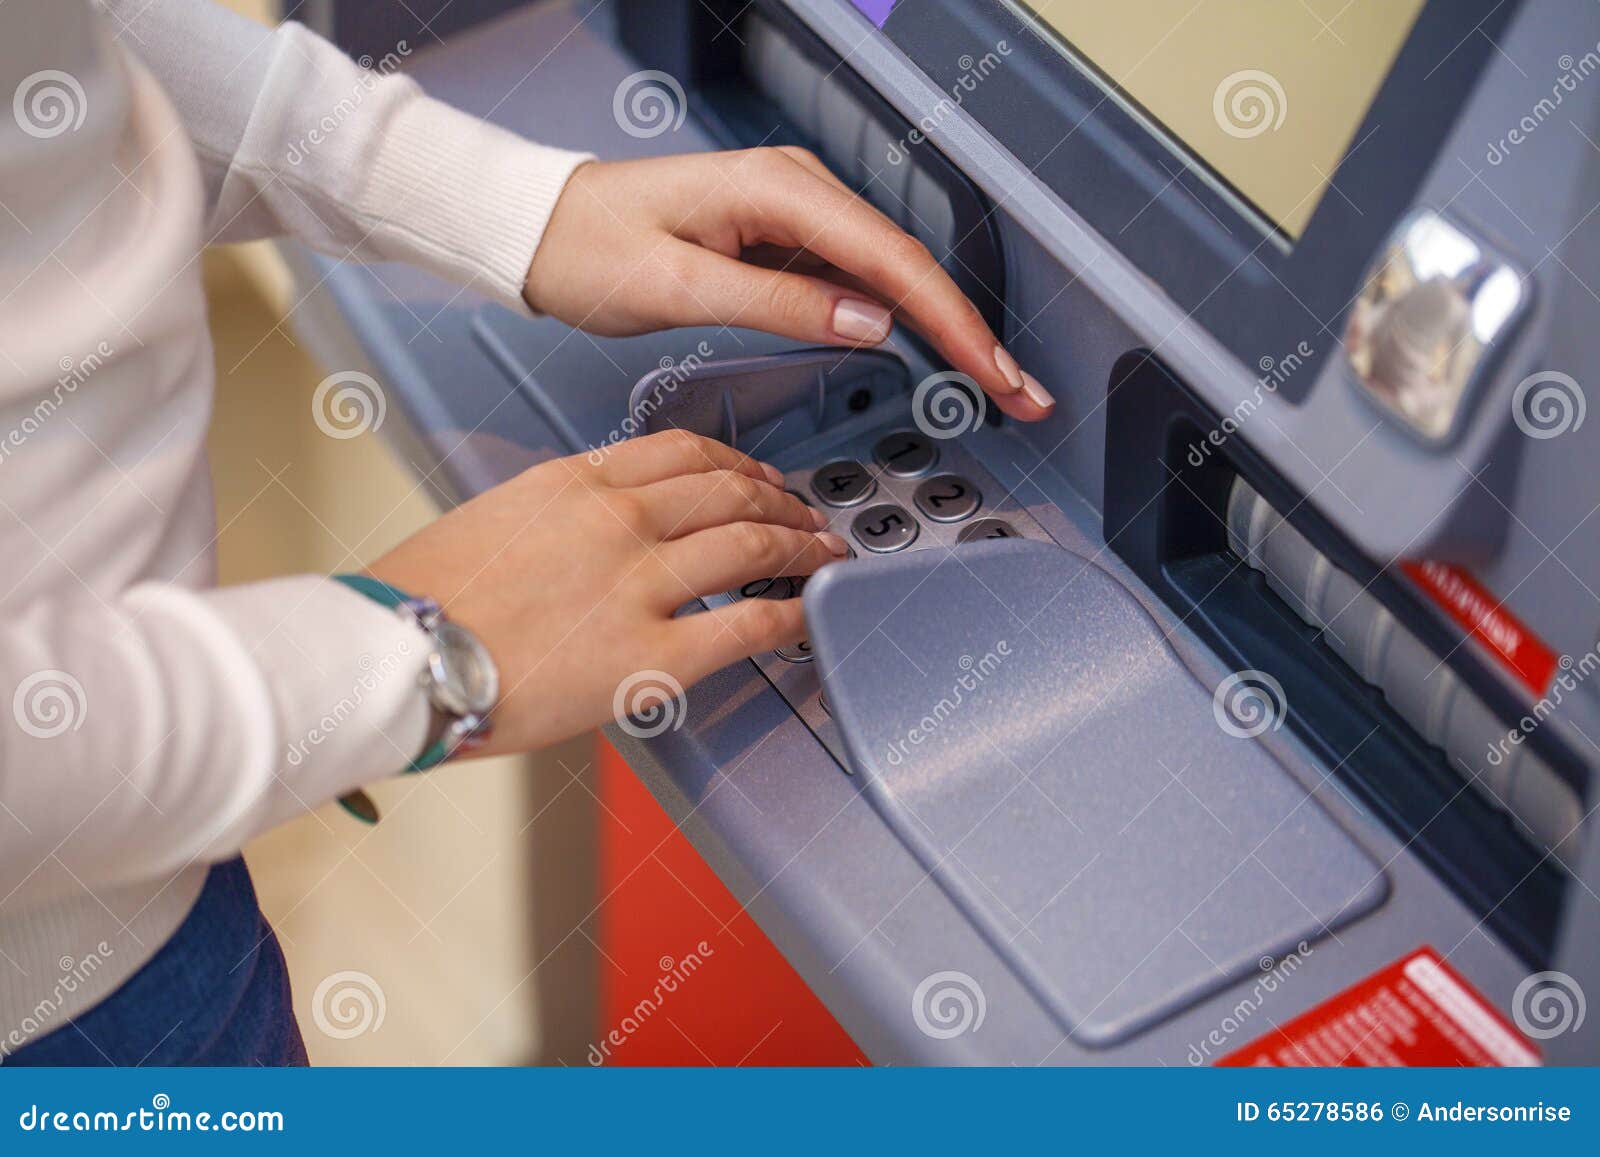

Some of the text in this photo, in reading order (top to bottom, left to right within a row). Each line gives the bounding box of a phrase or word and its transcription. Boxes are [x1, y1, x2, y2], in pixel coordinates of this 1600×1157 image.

[889, 442, 920, 461] 1
[828, 474, 858, 493] 4
[928, 484, 965, 508] 2
[865, 514, 902, 536] 5
